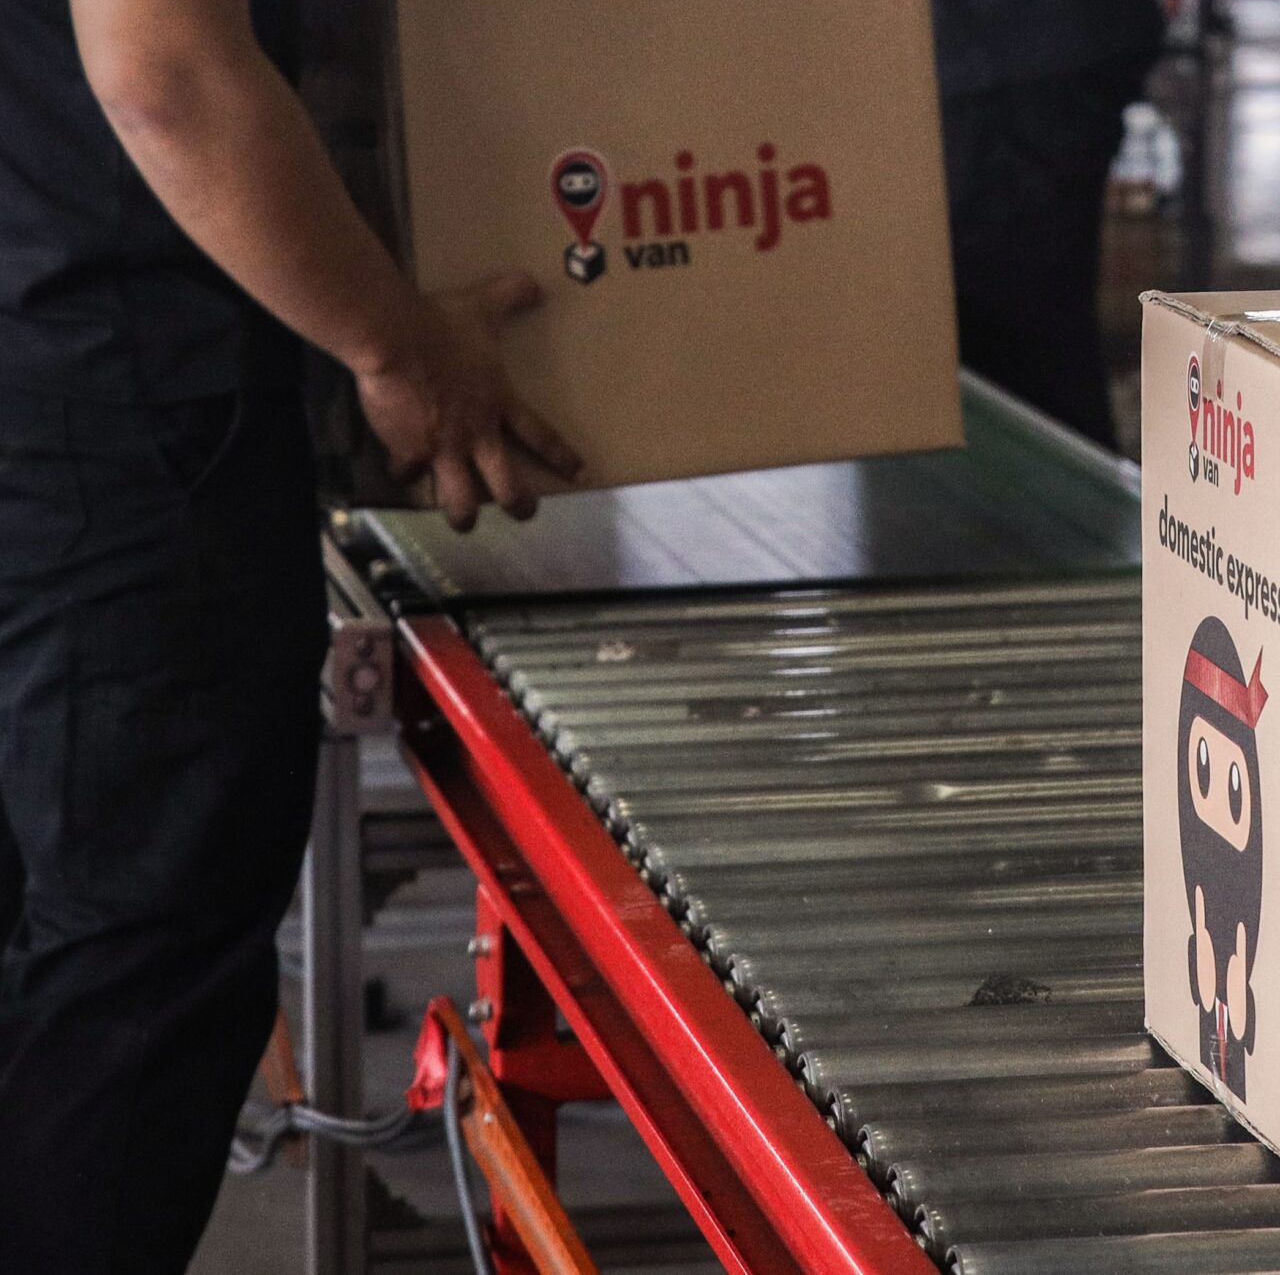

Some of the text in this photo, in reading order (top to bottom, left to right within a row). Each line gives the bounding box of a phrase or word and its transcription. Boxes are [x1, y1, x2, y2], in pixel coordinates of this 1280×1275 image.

[619, 141, 833, 252] ninja
[624, 241, 690, 270] van
[1202, 379, 1255, 496] ninja
[1203, 455, 1219, 487] van
[1159, 494, 1224, 586] domestic
